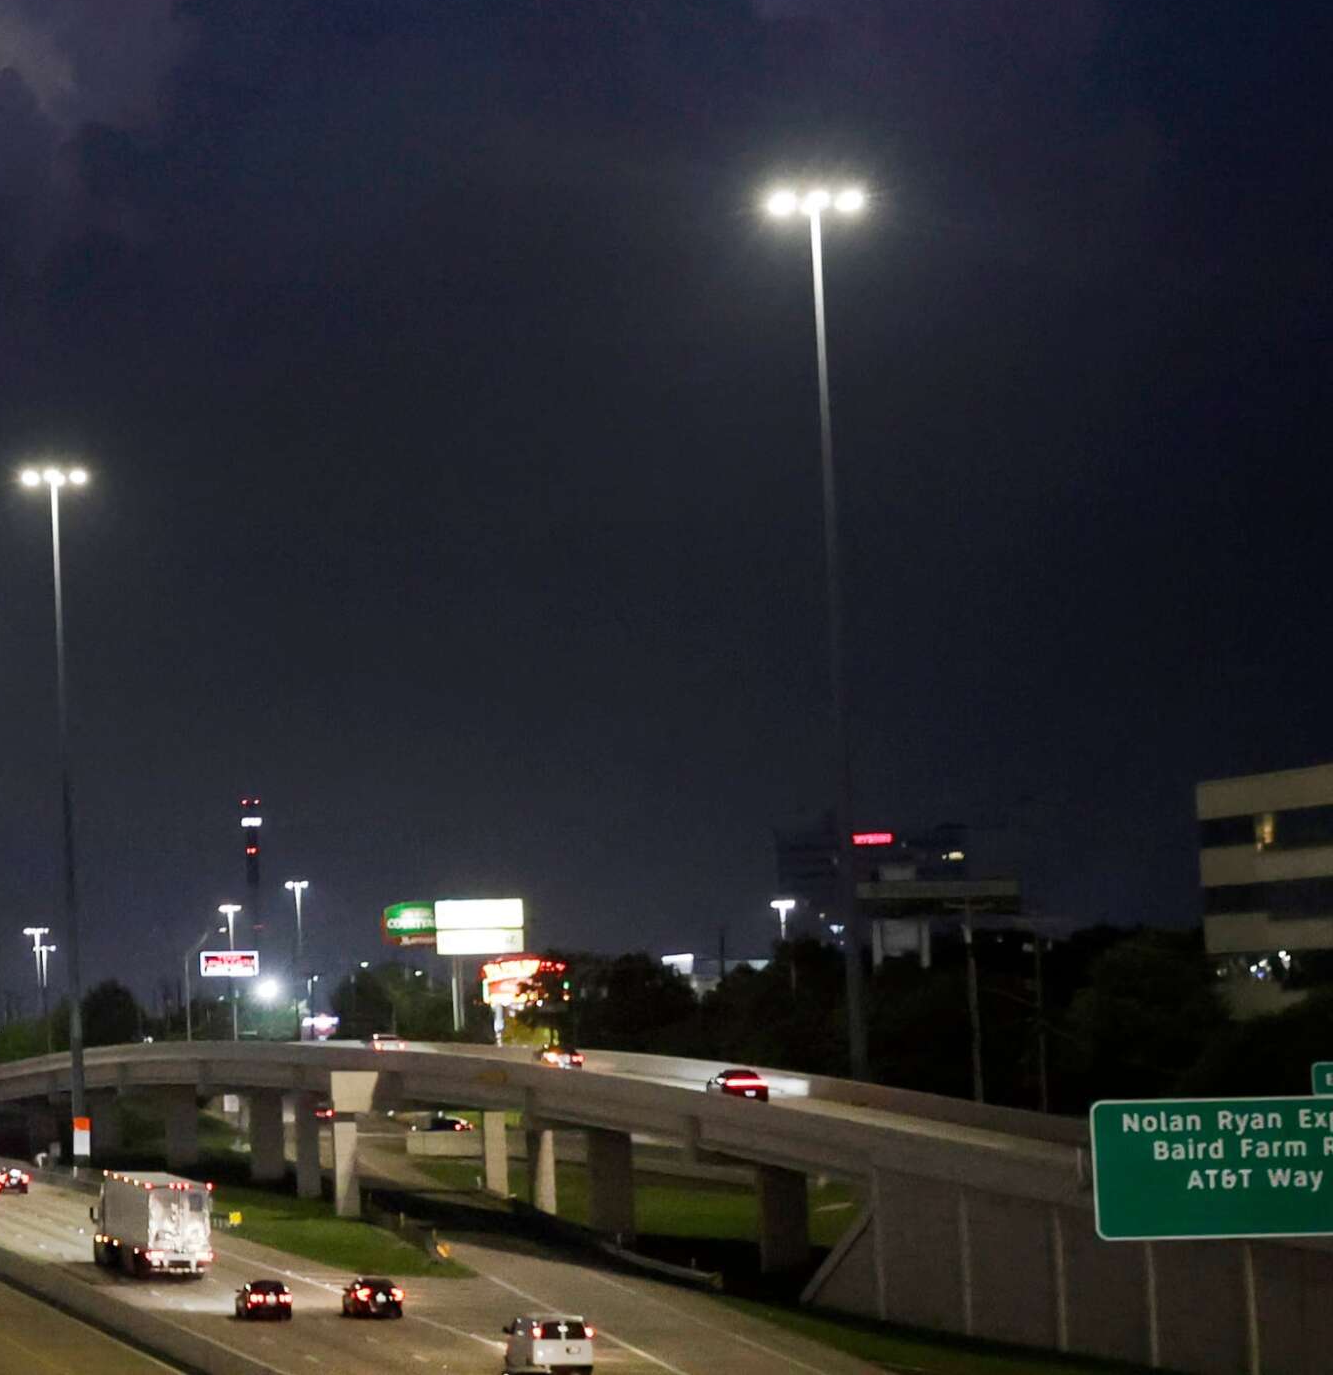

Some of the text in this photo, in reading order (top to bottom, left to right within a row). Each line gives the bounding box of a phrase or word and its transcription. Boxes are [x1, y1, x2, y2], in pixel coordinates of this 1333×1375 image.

[1122, 1111, 1202, 1133] Nolan
[1217, 1110, 1282, 1135] Ryan
[1153, 1139, 1224, 1160] Baird
[1240, 1138, 1307, 1158] Farm
[1187, 1168, 1323, 1192] AT&T Way
